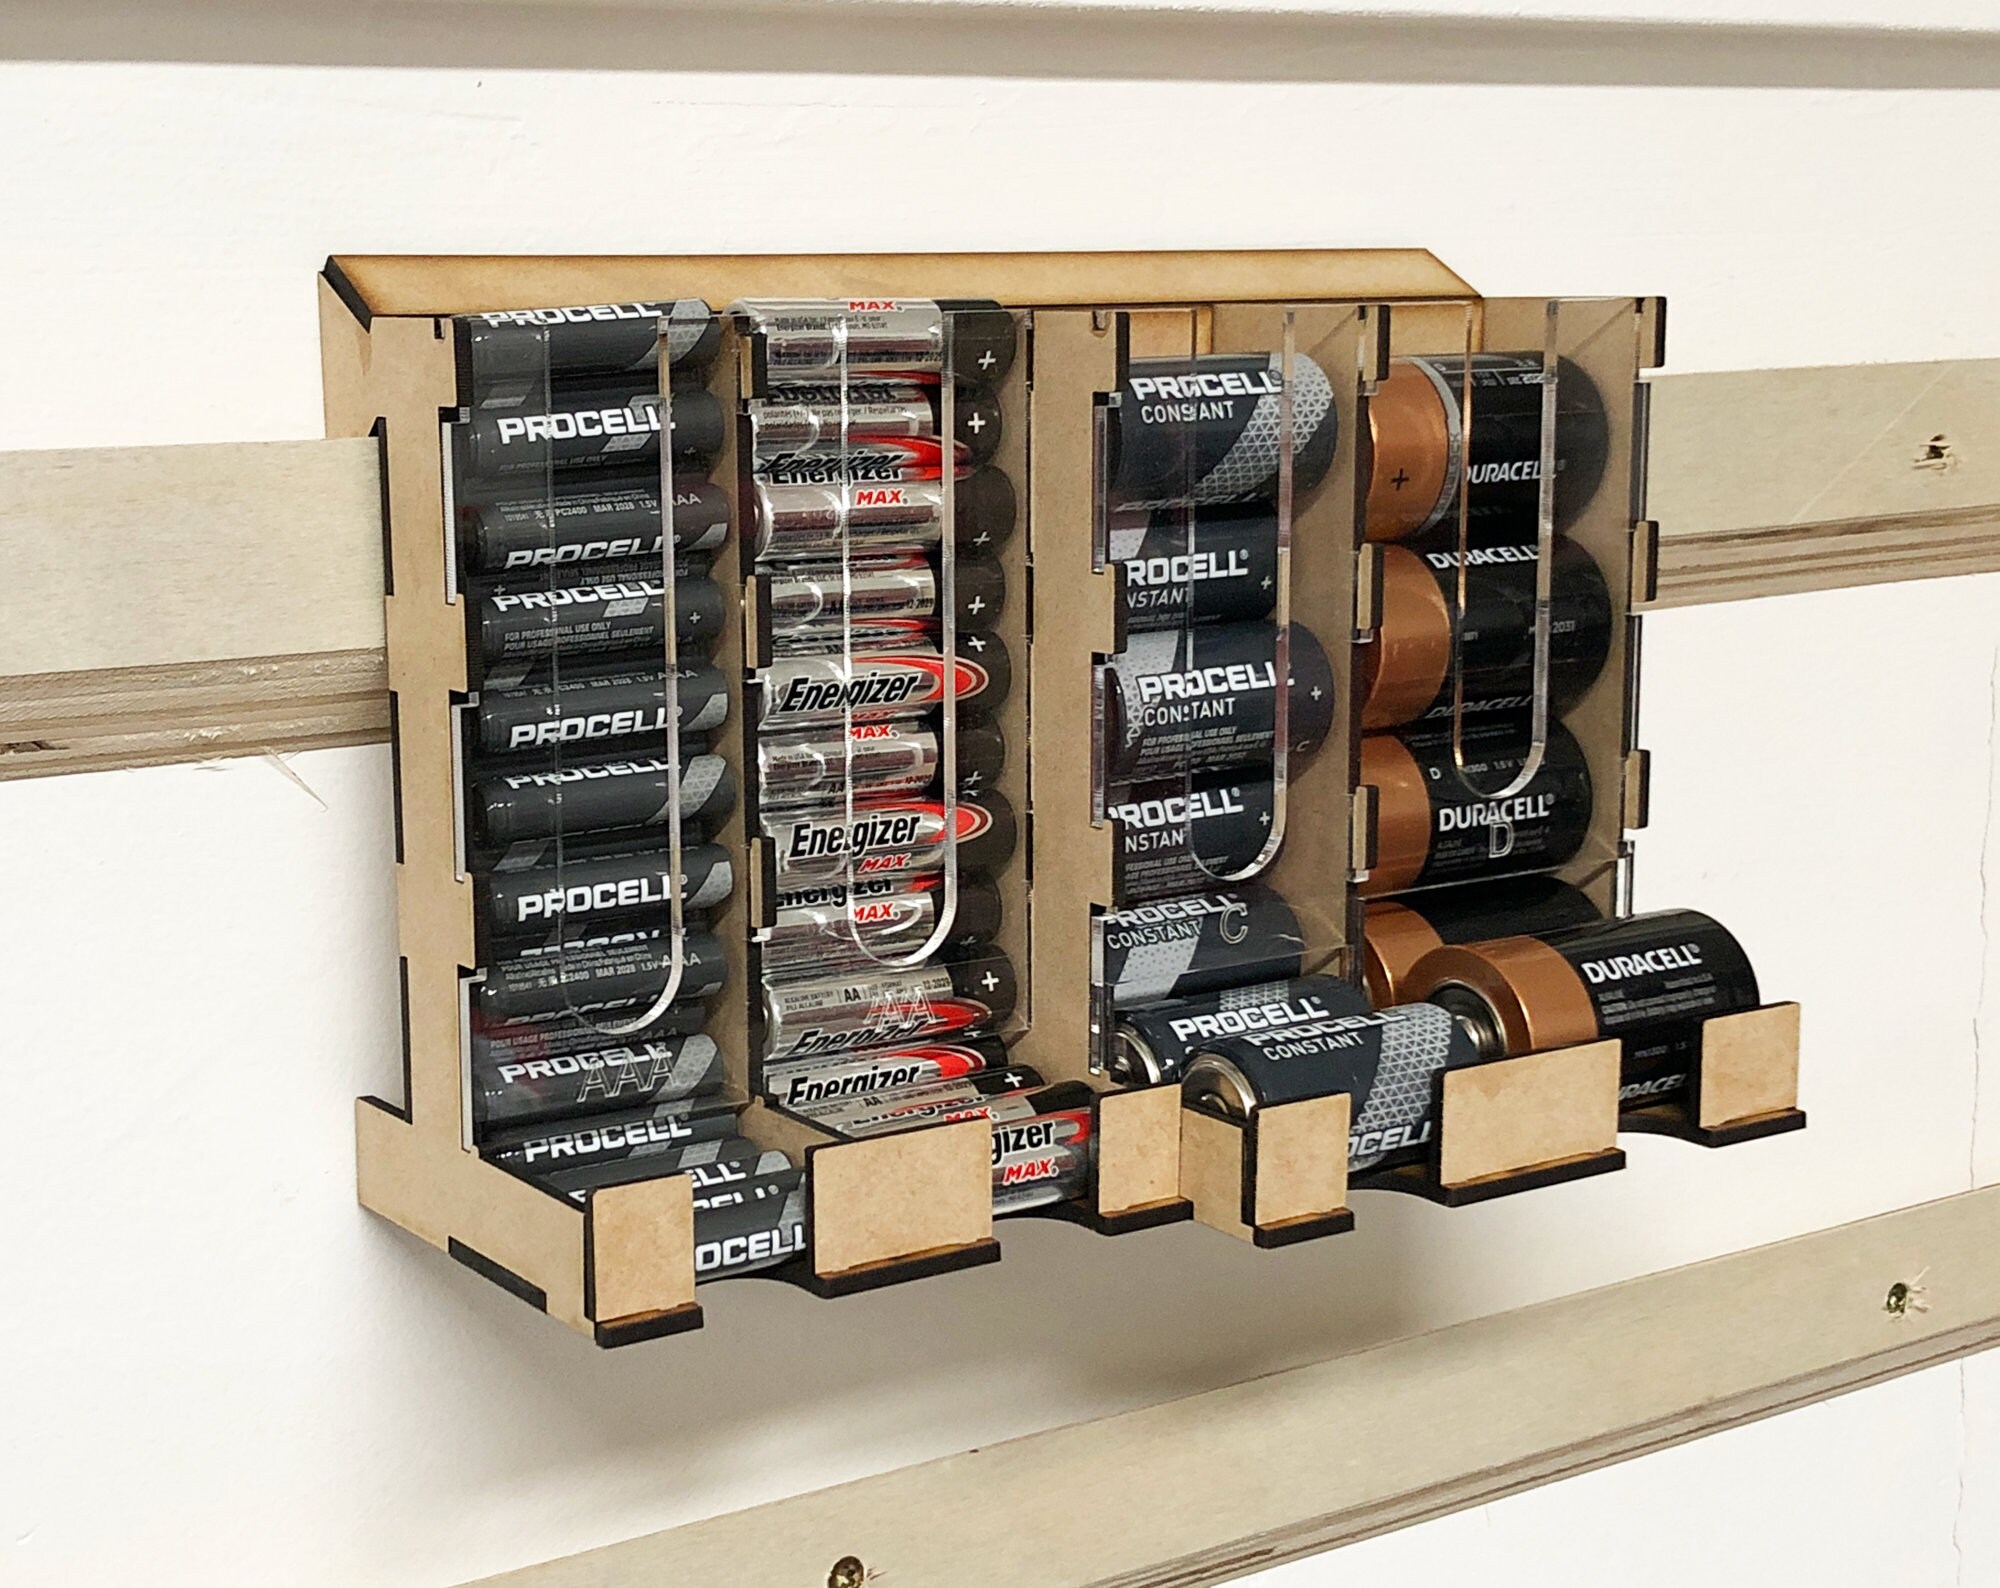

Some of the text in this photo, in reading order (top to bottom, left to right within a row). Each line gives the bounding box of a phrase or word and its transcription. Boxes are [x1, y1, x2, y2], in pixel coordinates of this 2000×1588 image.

[849, 301, 895, 313] MAX
[1129, 371, 1283, 401] PROCELL
[497, 405, 676, 445] PROCELL
[760, 450, 904, 475] Enerizer
[771, 464, 902, 491] Enerizer
[1466, 460, 1557, 484] URACEL
[668, 491, 702, 508] AA
[856, 489, 902, 505] MAX
[504, 535, 665, 570] PROCELL
[1427, 546, 1540, 570] DURACELL
[1124, 550, 1249, 588] ROCELL
[491, 580, 667, 611] PROCELL
[1127, 587, 1190, 609] NSTAN
[1137, 661, 1295, 703] PROCELL
[509, 707, 680, 749] PROCELL
[849, 725, 892, 741] MAX
[1429, 767, 1442, 780] D
[1439, 795, 1550, 832] DURACELL
[789, 814, 922, 859] Enegizer
[1125, 828, 1186, 853] NSTAN
[1488, 820, 1514, 859] D
[859, 853, 911, 873] MAX
[517, 875, 687, 923] PROCELL
[776, 879, 892, 907] nergzer
[853, 902, 893, 923] MAX
[1219, 903, 1249, 945] C
[1107, 919, 1202, 950] CONSTANT
[1581, 944, 1702, 985] DURACELL
[844, 987, 862, 1003] AA
[1169, 998, 1331, 1042] PROCELL
[1240, 1011, 1408, 1047] PROCELL
[1263, 1032, 1366, 1062] CONSTANT
[498, 1043, 673, 1084] PROCELL
[576, 1043, 678, 1103] AAA
[523, 1115, 693, 1163] PROCELL
[992, 1120, 1054, 1165] gizer
[1347, 1121, 1432, 1158] OCELL
[1005, 1158, 1052, 1182] MAX
[696, 1224, 807, 1272] OCELL
